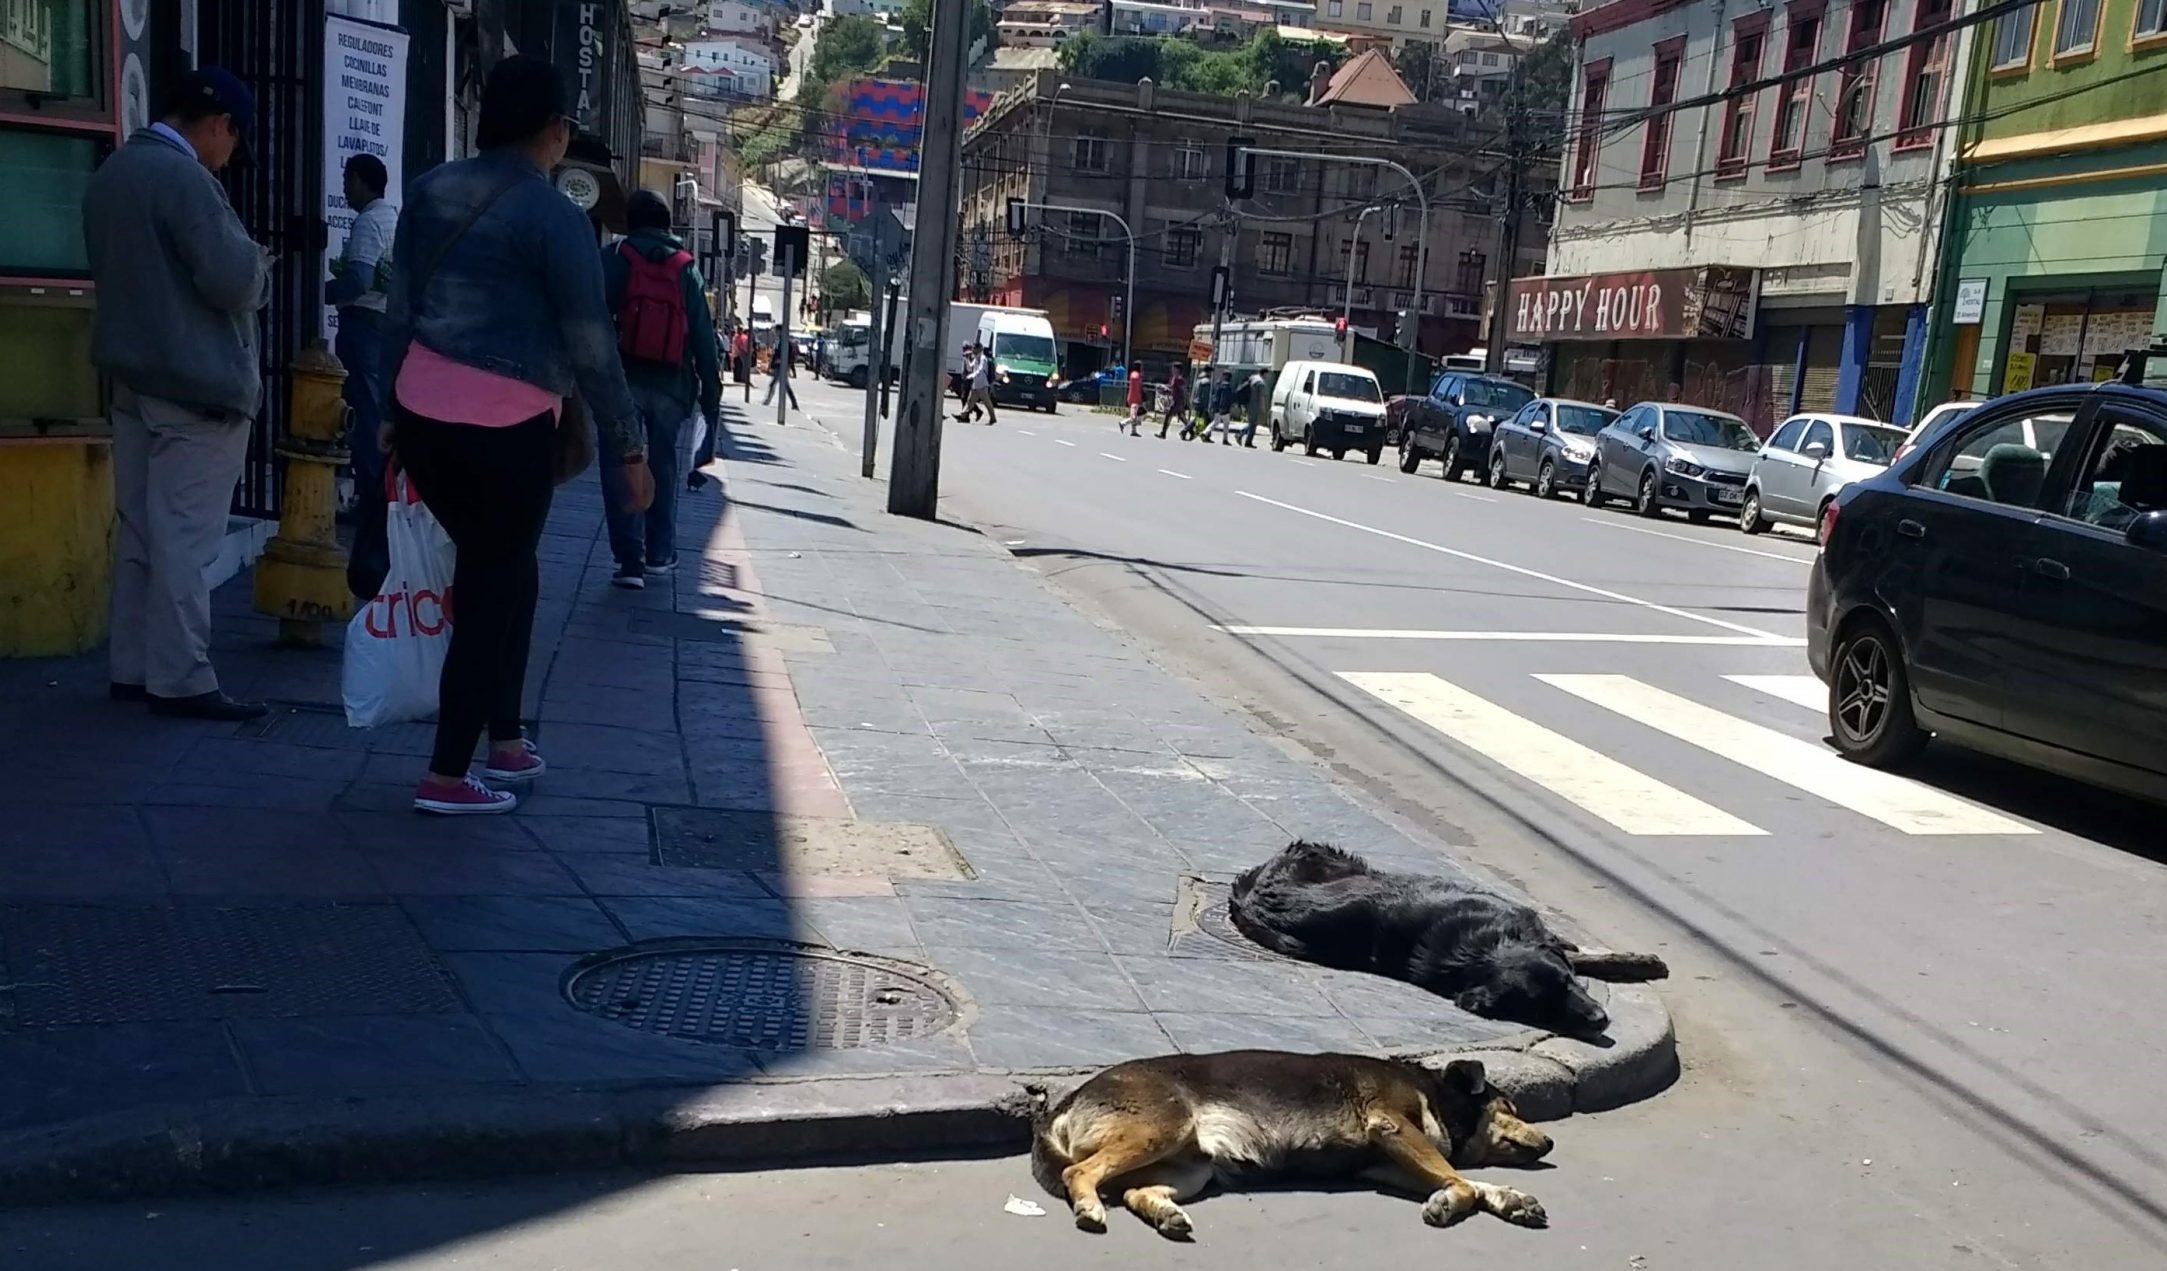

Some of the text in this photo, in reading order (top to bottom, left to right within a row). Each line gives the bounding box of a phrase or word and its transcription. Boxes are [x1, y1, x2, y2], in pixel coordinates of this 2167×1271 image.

[338, 33, 394, 58] REGULADORES
[344, 55, 387, 77] COCINILLAS
[576, 3, 595, 131] HOSTAL
[348, 96, 384, 116] CALEFONT
[371, 122, 381, 136] DE
[1516, 280, 1662, 333] HAPPY HOUR
